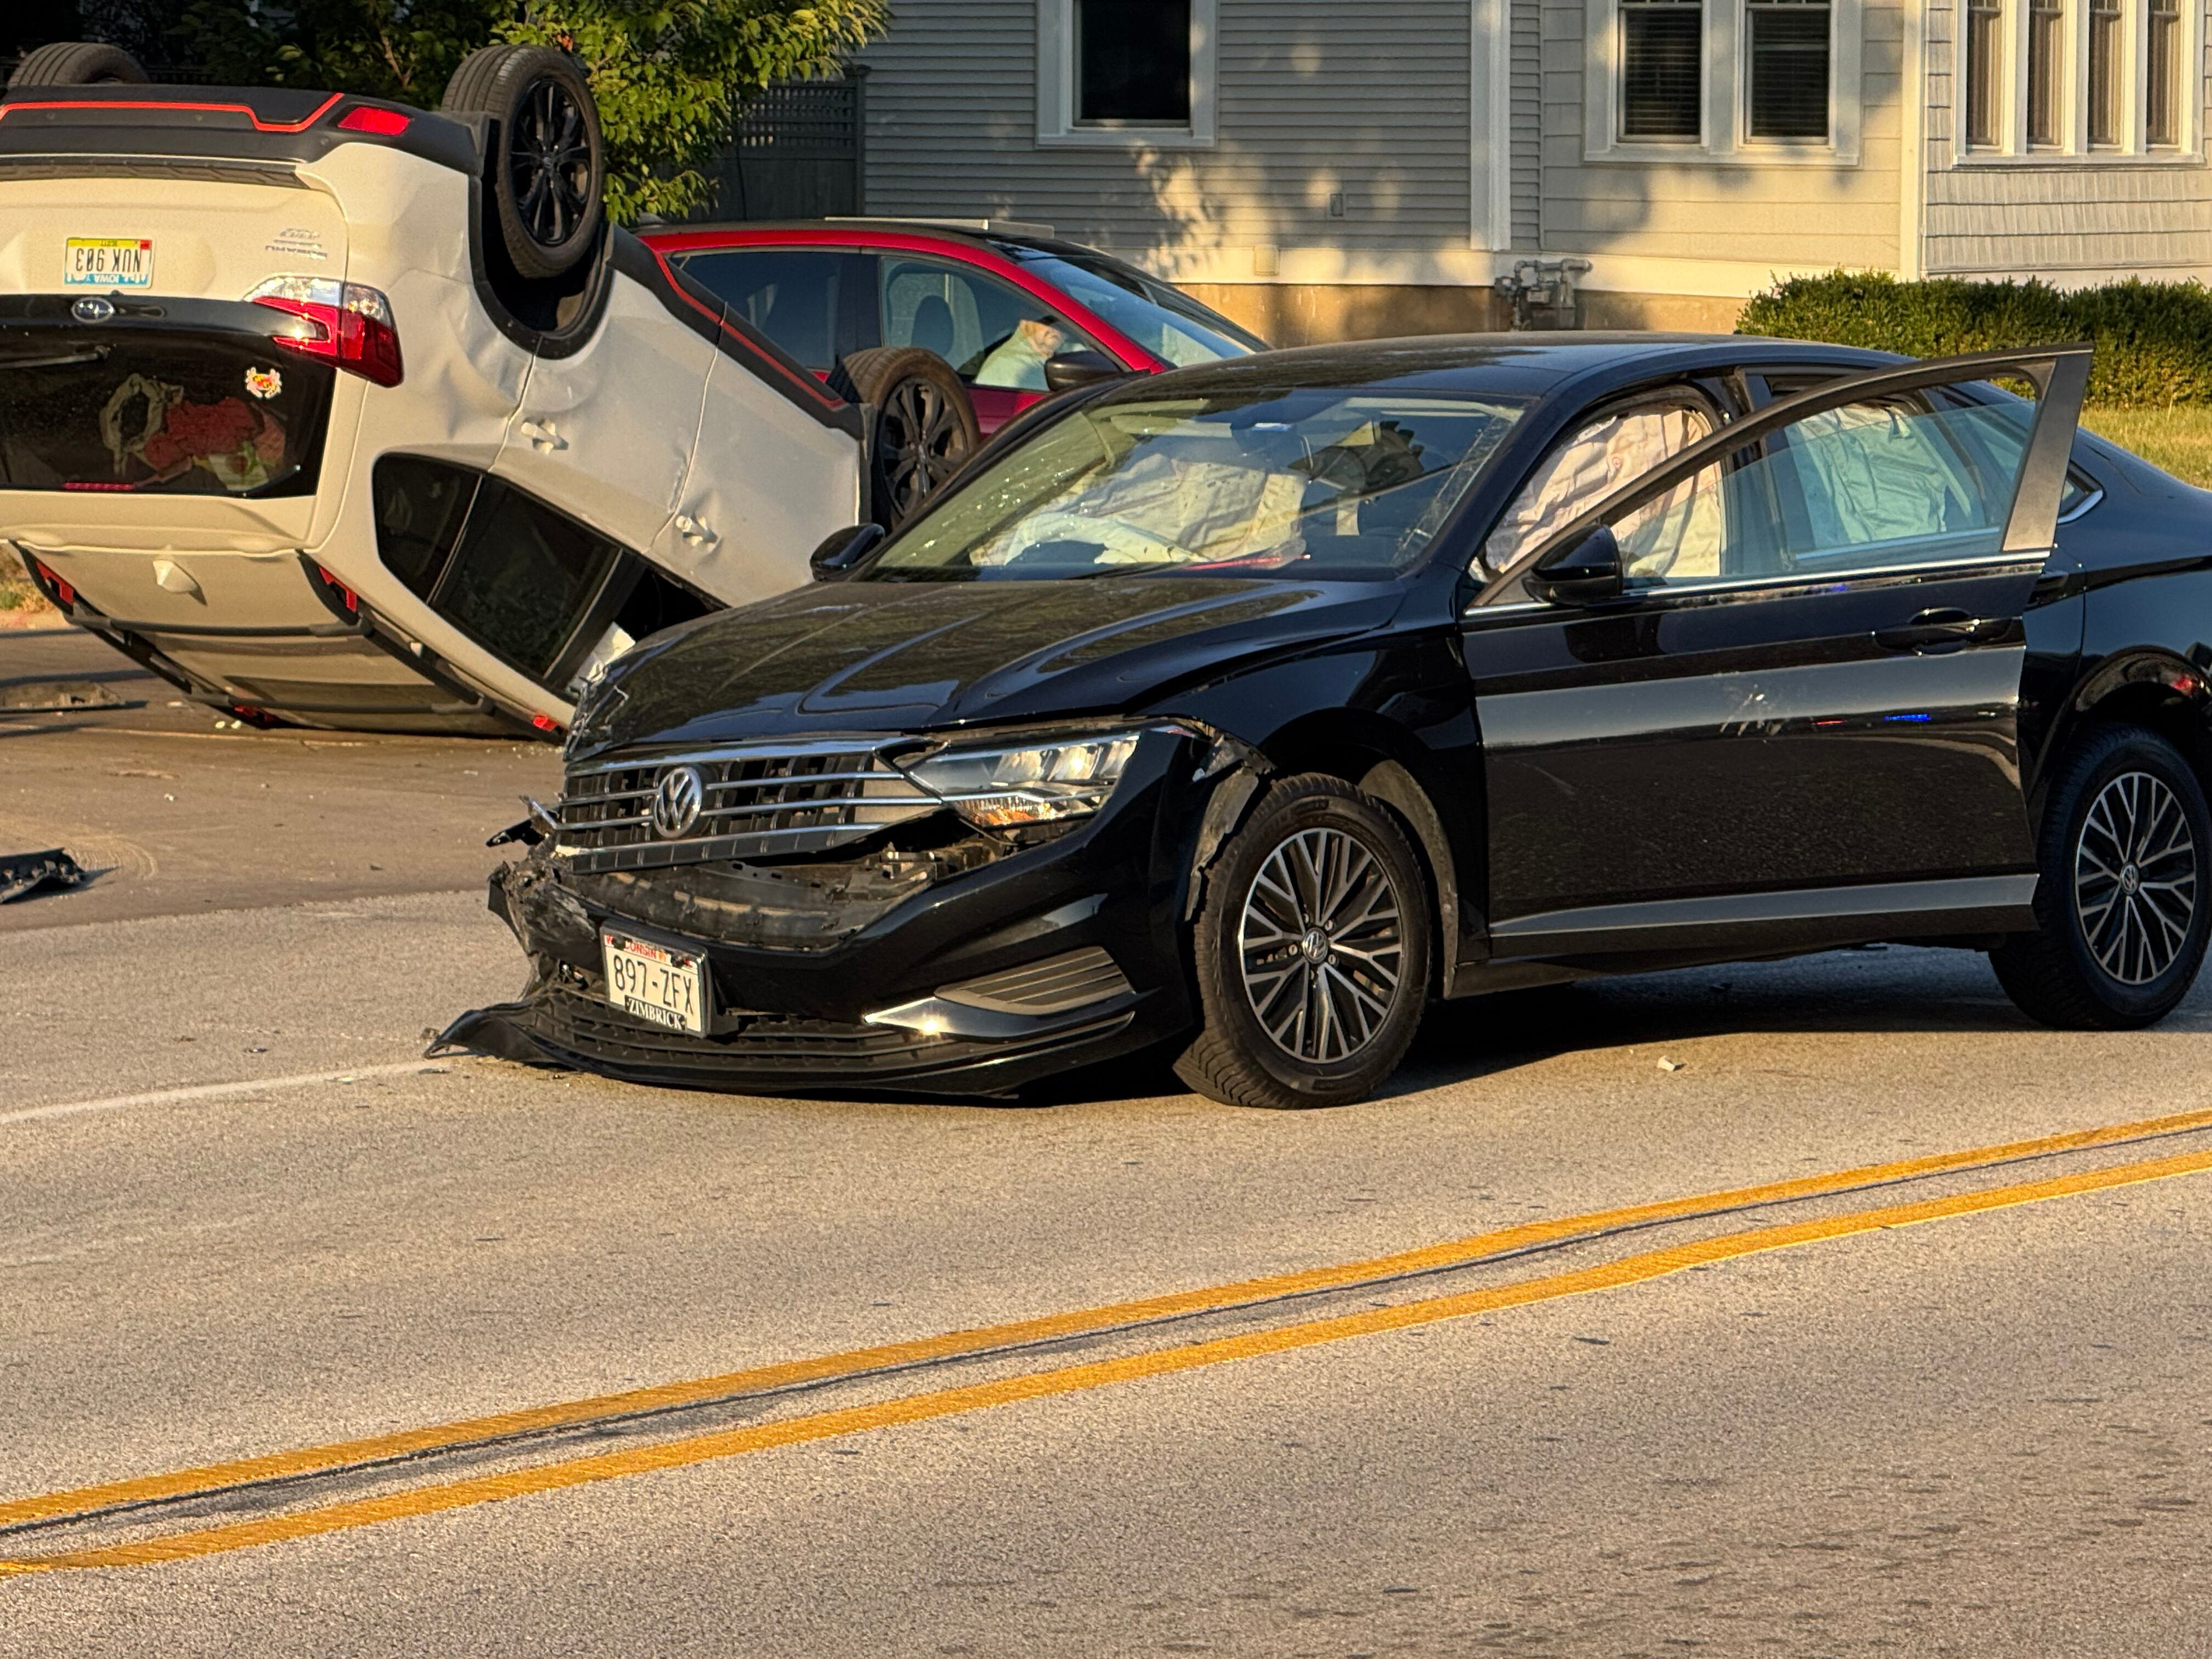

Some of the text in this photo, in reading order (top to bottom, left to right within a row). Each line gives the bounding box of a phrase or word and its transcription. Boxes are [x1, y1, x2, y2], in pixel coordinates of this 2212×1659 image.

[76, 248, 141, 272] NUK 903
[94, 274, 119, 283] IOWA
[606, 935, 657, 959] WCONSIN
[614, 954, 693, 1015] 897-ZFX
[628, 997, 682, 1030] ZIMBRICK
